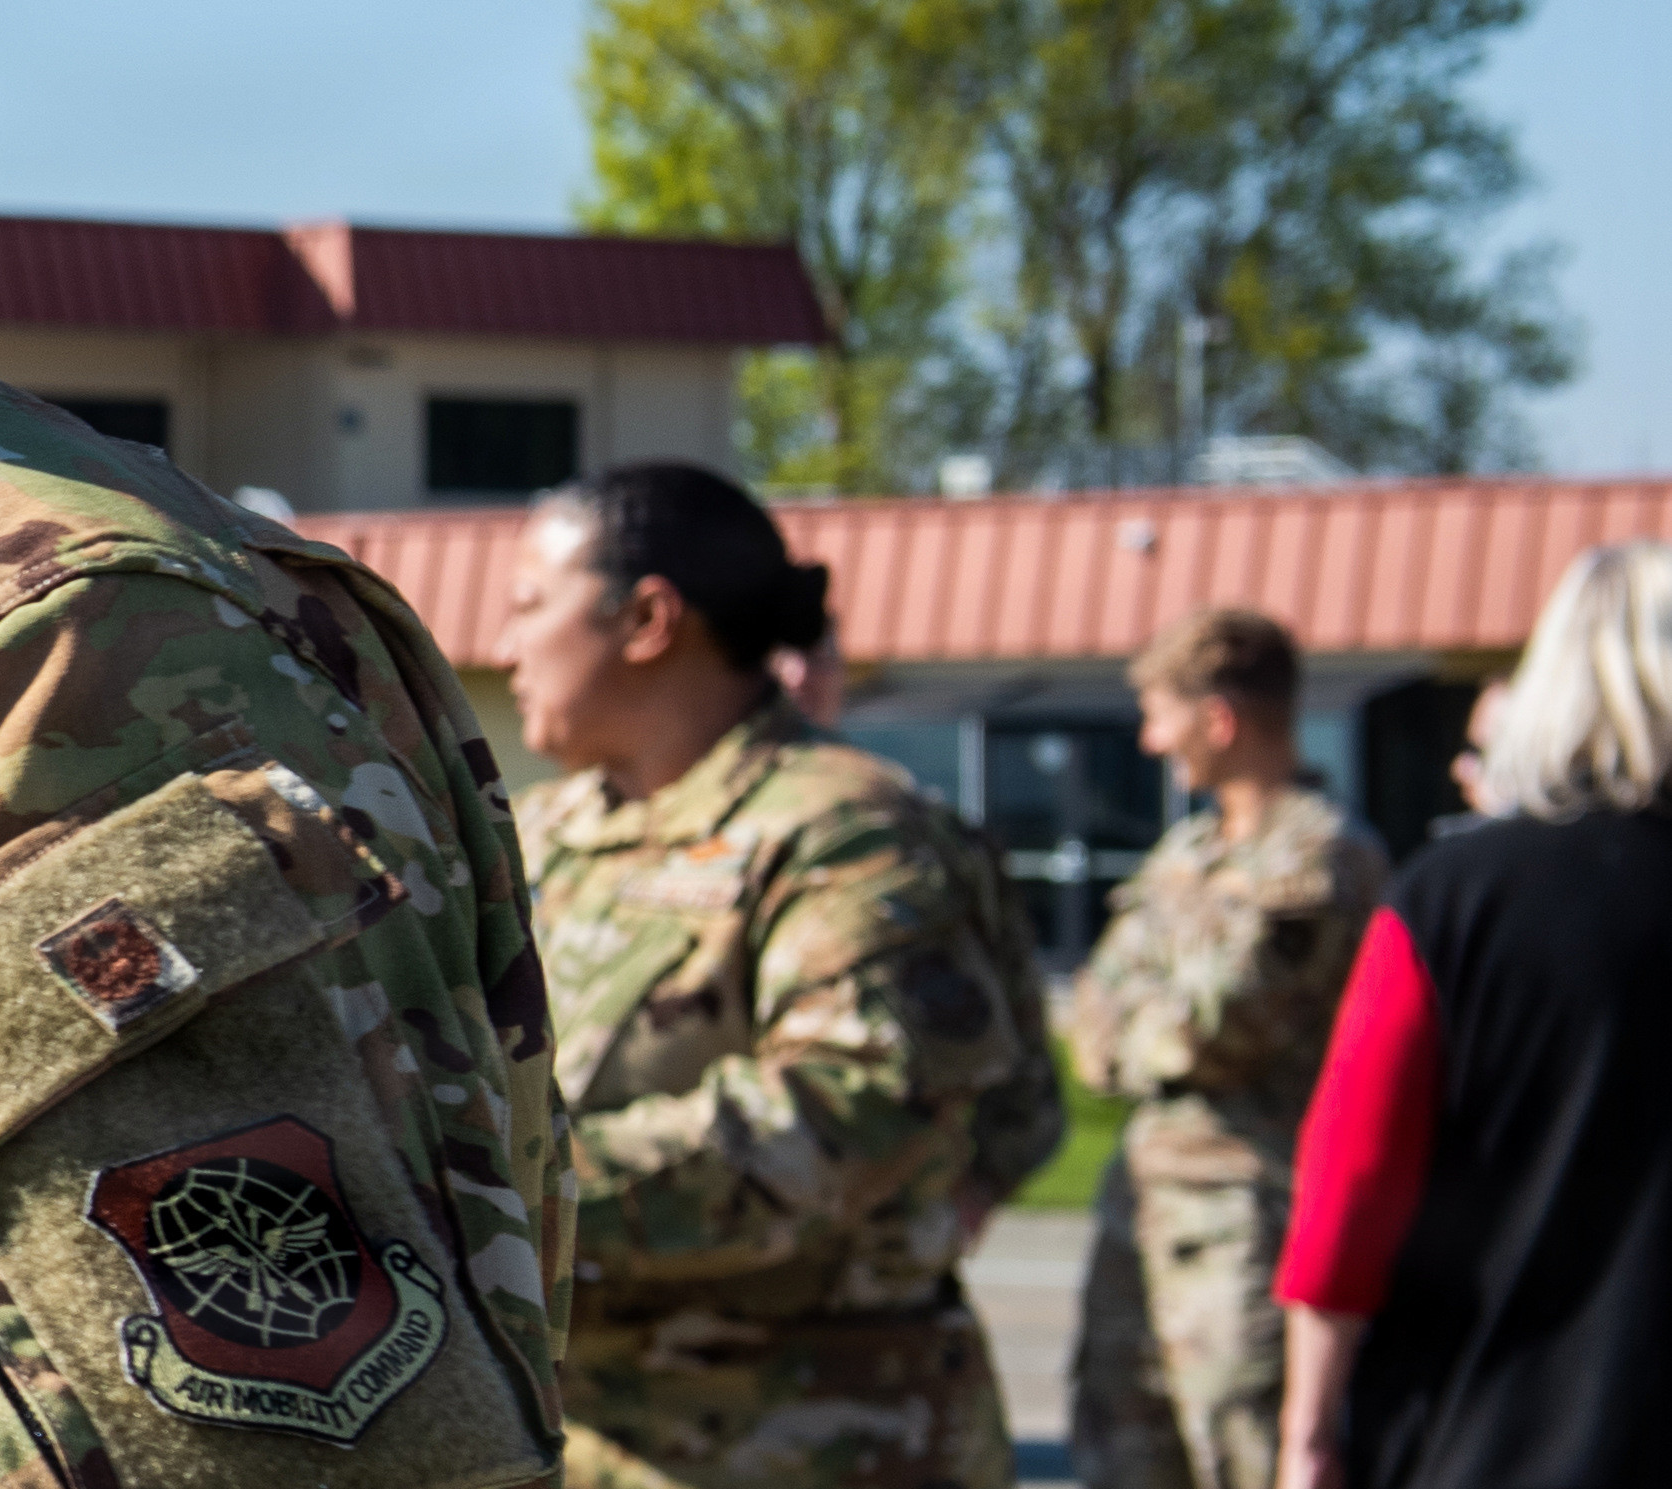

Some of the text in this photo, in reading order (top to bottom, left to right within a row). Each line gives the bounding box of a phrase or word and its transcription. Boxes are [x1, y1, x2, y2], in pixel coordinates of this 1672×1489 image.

[175, 1309, 431, 1429] AIR MOBILITY COMMAND
